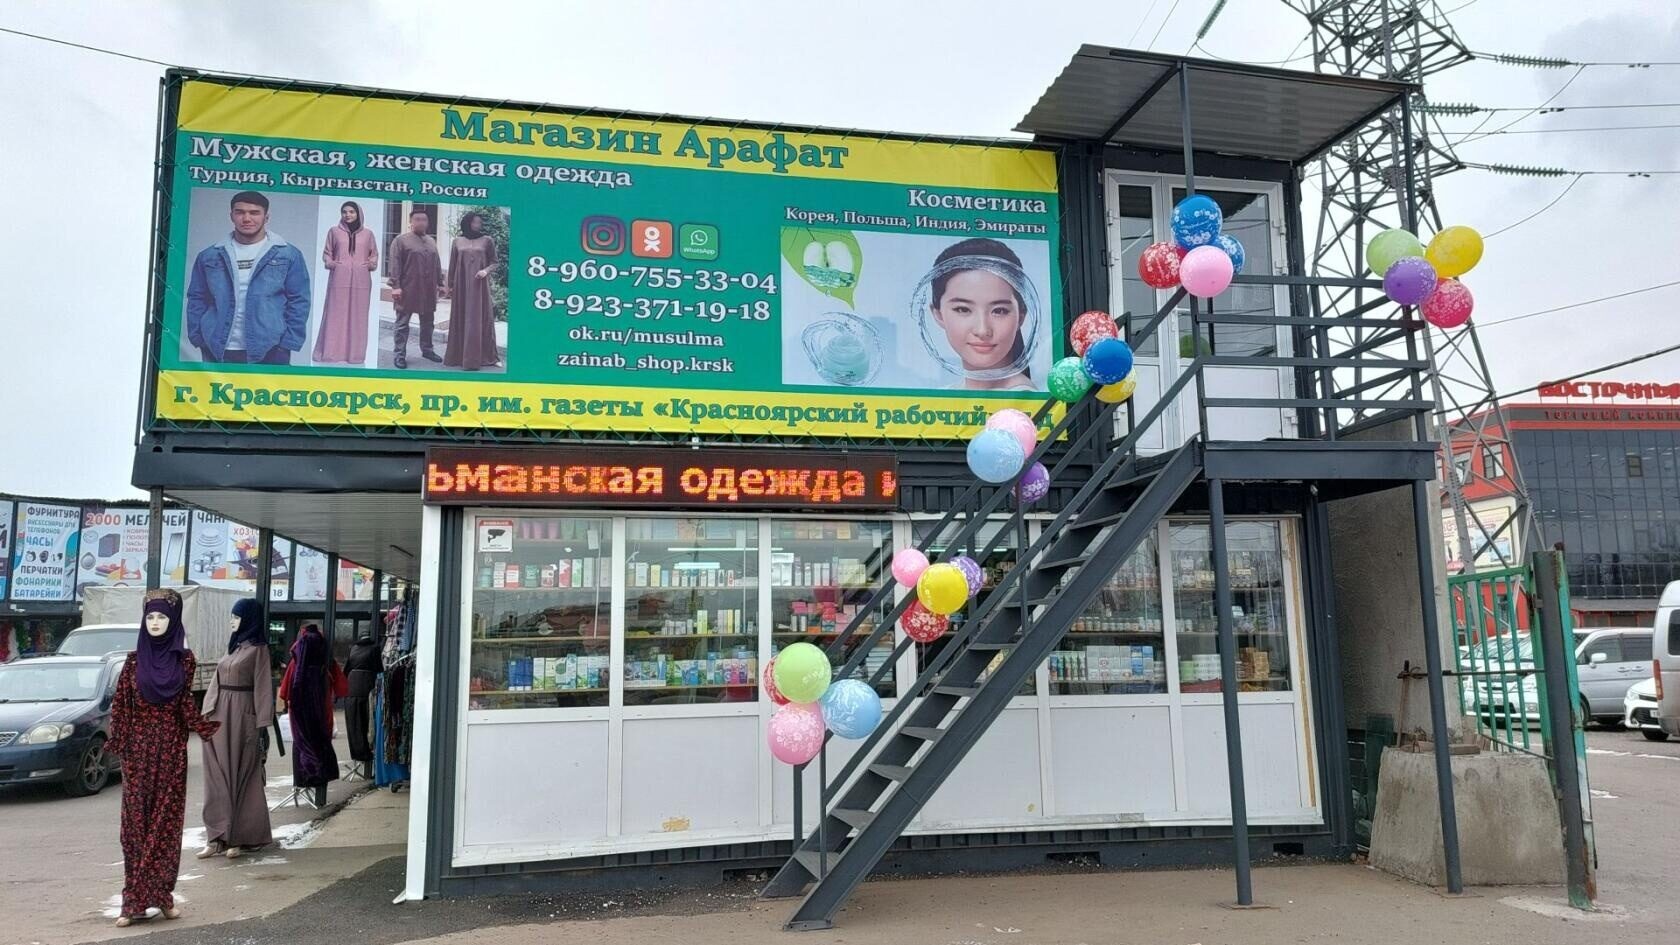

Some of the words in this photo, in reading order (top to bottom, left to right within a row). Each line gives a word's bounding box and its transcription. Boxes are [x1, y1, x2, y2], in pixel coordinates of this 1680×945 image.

[440, 108, 662, 155] Магазин
[674, 128, 849, 174] Арафат
[190, 136, 356, 171] Мужская,
[366, 150, 505, 177] женская
[515, 163, 633, 188] одежда
[190, 165, 275, 187] Турция,
[281, 171, 416, 196] Кыргызстан,
[420, 180, 488, 200] Россия
[908, 189, 1047, 214] Косметика
[785, 207, 839, 224] Корея,
[844, 211, 911, 229] Польша,
[915, 216, 972, 232] Индия,
[975, 218, 1047, 235] Эмираты
[527, 256, 778, 295] 8-960-755-33-04
[534, 288, 771, 323] 8-923-371-19-18
[569, 326, 724, 348] ok.ru/musulma
[558, 352, 735, 375] zainab_shop.krsk
[1538, 381, 1680, 399] ВОСТОЧНЫ
[174, 385, 199, 403] г.
[209, 382, 410, 413] Красноярск,
[420, 393, 468, 417] пр.
[478, 396, 531, 413] им.
[541, 397, 643, 417] газеты
[653, 398, 868, 424] «Красноярский
[427, 464, 663, 494] ьманская
[680, 468, 865, 501] одежда
[27, 506, 80, 519] ФУРНИТУРА
[86, 512, 121, 526] 2000
[125, 512, 186, 526] МЕЛЧЕЙ
[26, 535, 54, 547] ЧАСЫ
[15, 576, 61, 586] ФОНАРИКИ
[20, 565, 63, 575] ПЕРЧАТКИ
[14, 588, 61, 599] БАТАРЕЙКИ
[273, 588, 284, 597] 18
